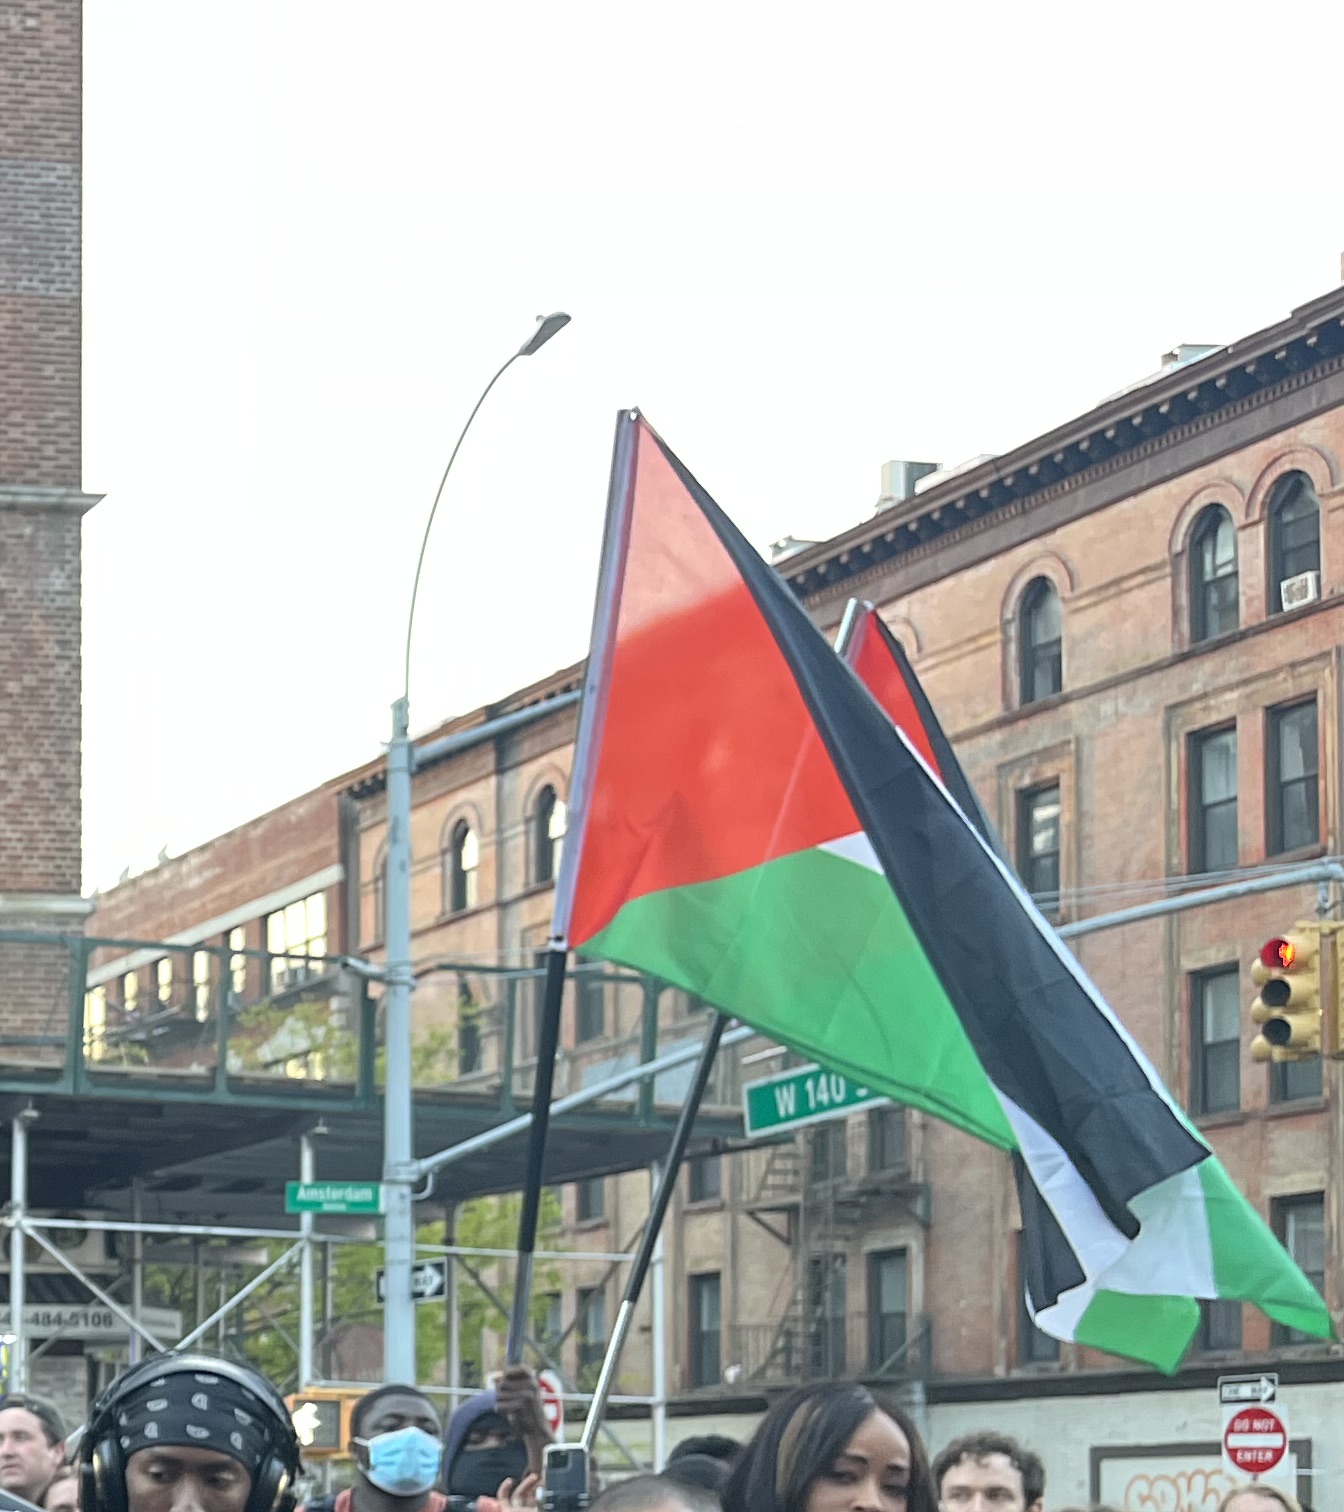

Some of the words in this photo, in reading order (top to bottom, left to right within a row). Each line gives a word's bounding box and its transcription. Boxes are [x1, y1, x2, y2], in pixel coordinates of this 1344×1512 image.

[774, 1083, 795, 1119] W
[804, 1072, 846, 1110] 140
[297, 1185, 373, 1202] Amsterdam
[1233, 1418, 1250, 1432] DO
[1252, 1418, 1275, 1432] NOT
[1236, 1449, 1273, 1464] ENTER
